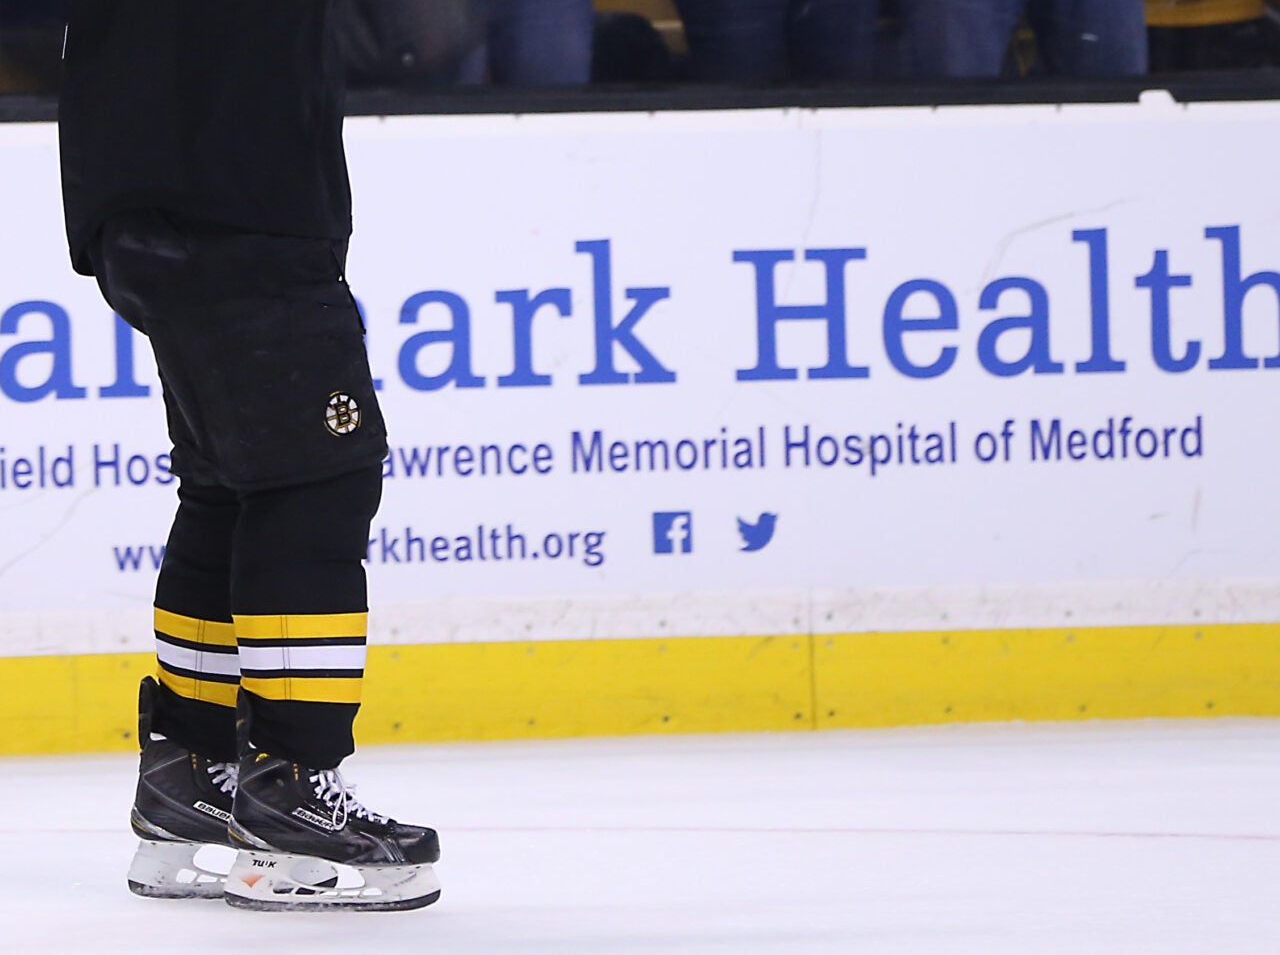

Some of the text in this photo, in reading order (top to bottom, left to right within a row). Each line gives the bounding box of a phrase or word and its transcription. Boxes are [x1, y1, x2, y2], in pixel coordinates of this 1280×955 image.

[732, 224, 1280, 382] Health
[381, 415, 1204, 479] awrence Memorial Hospital of Medford
